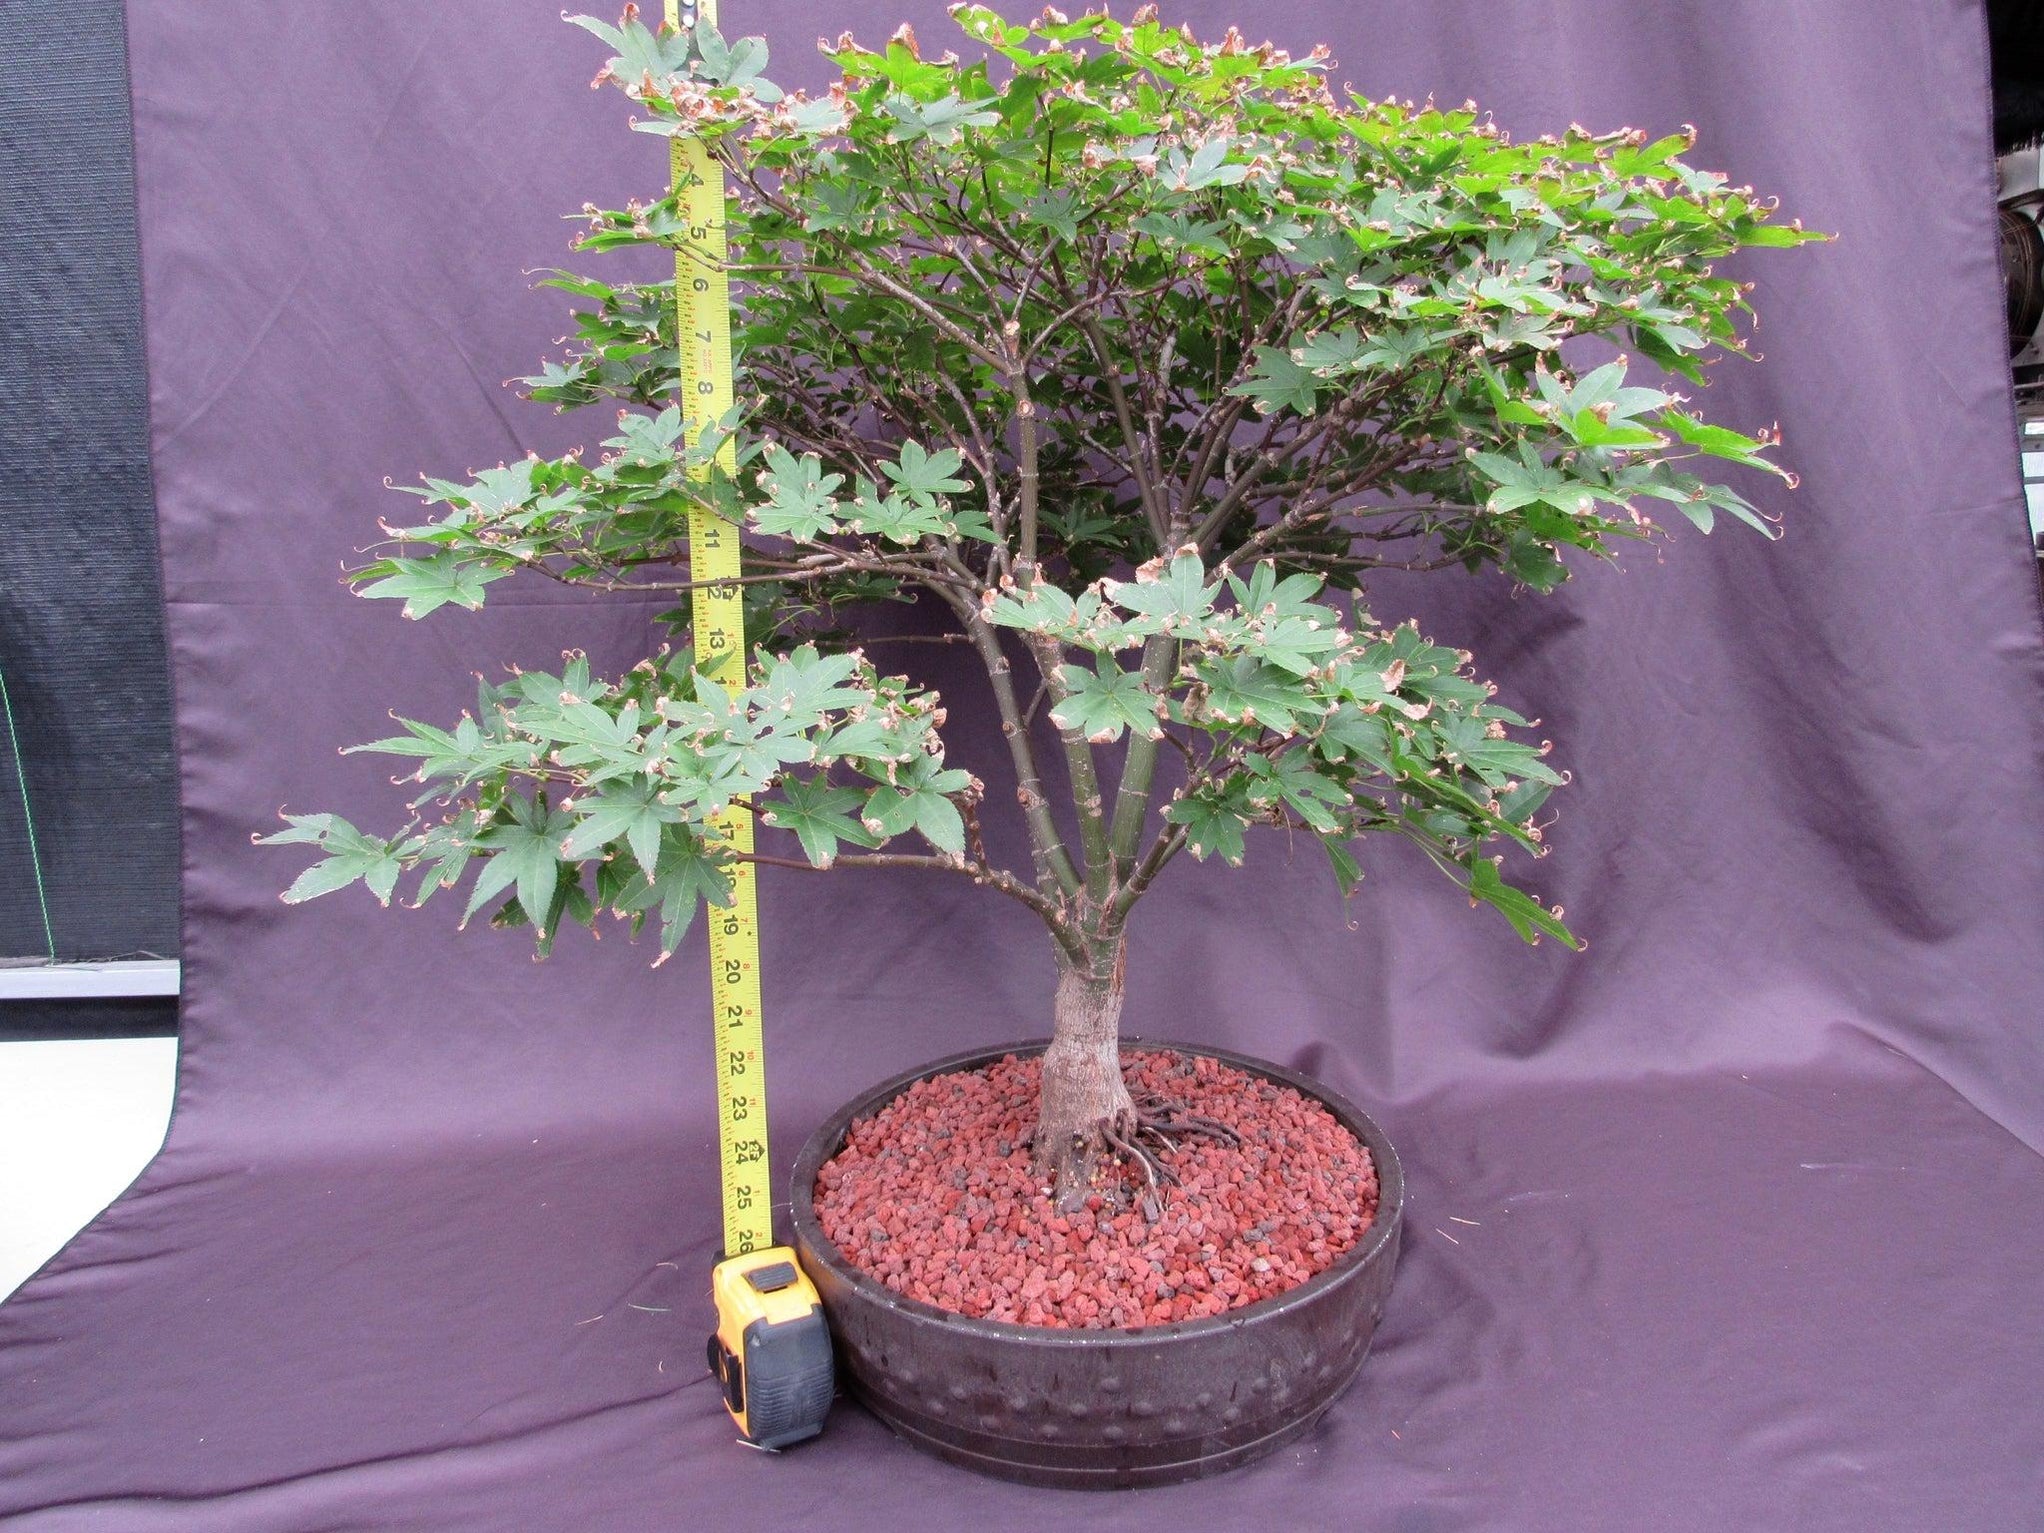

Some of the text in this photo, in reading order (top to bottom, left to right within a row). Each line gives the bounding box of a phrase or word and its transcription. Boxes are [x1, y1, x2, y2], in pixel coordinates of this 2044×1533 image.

[691, 226, 707, 240] 5
[693, 278, 709, 292] 6
[695, 330, 711, 343] 7
[697, 381, 714, 395] 8
[704, 529, 720, 548] 11
[709, 628, 726, 650] 13
[719, 820, 735, 841] 17
[723, 914, 739, 936] 19
[725, 959, 741, 985] 20
[727, 1005, 743, 1028] 21
[730, 1051, 746, 1076] 22
[732, 1096, 748, 1121] 23
[735, 1141, 749, 1165] 24
[737, 1185, 752, 1210] 25
[739, 1229, 754, 1254] 26
